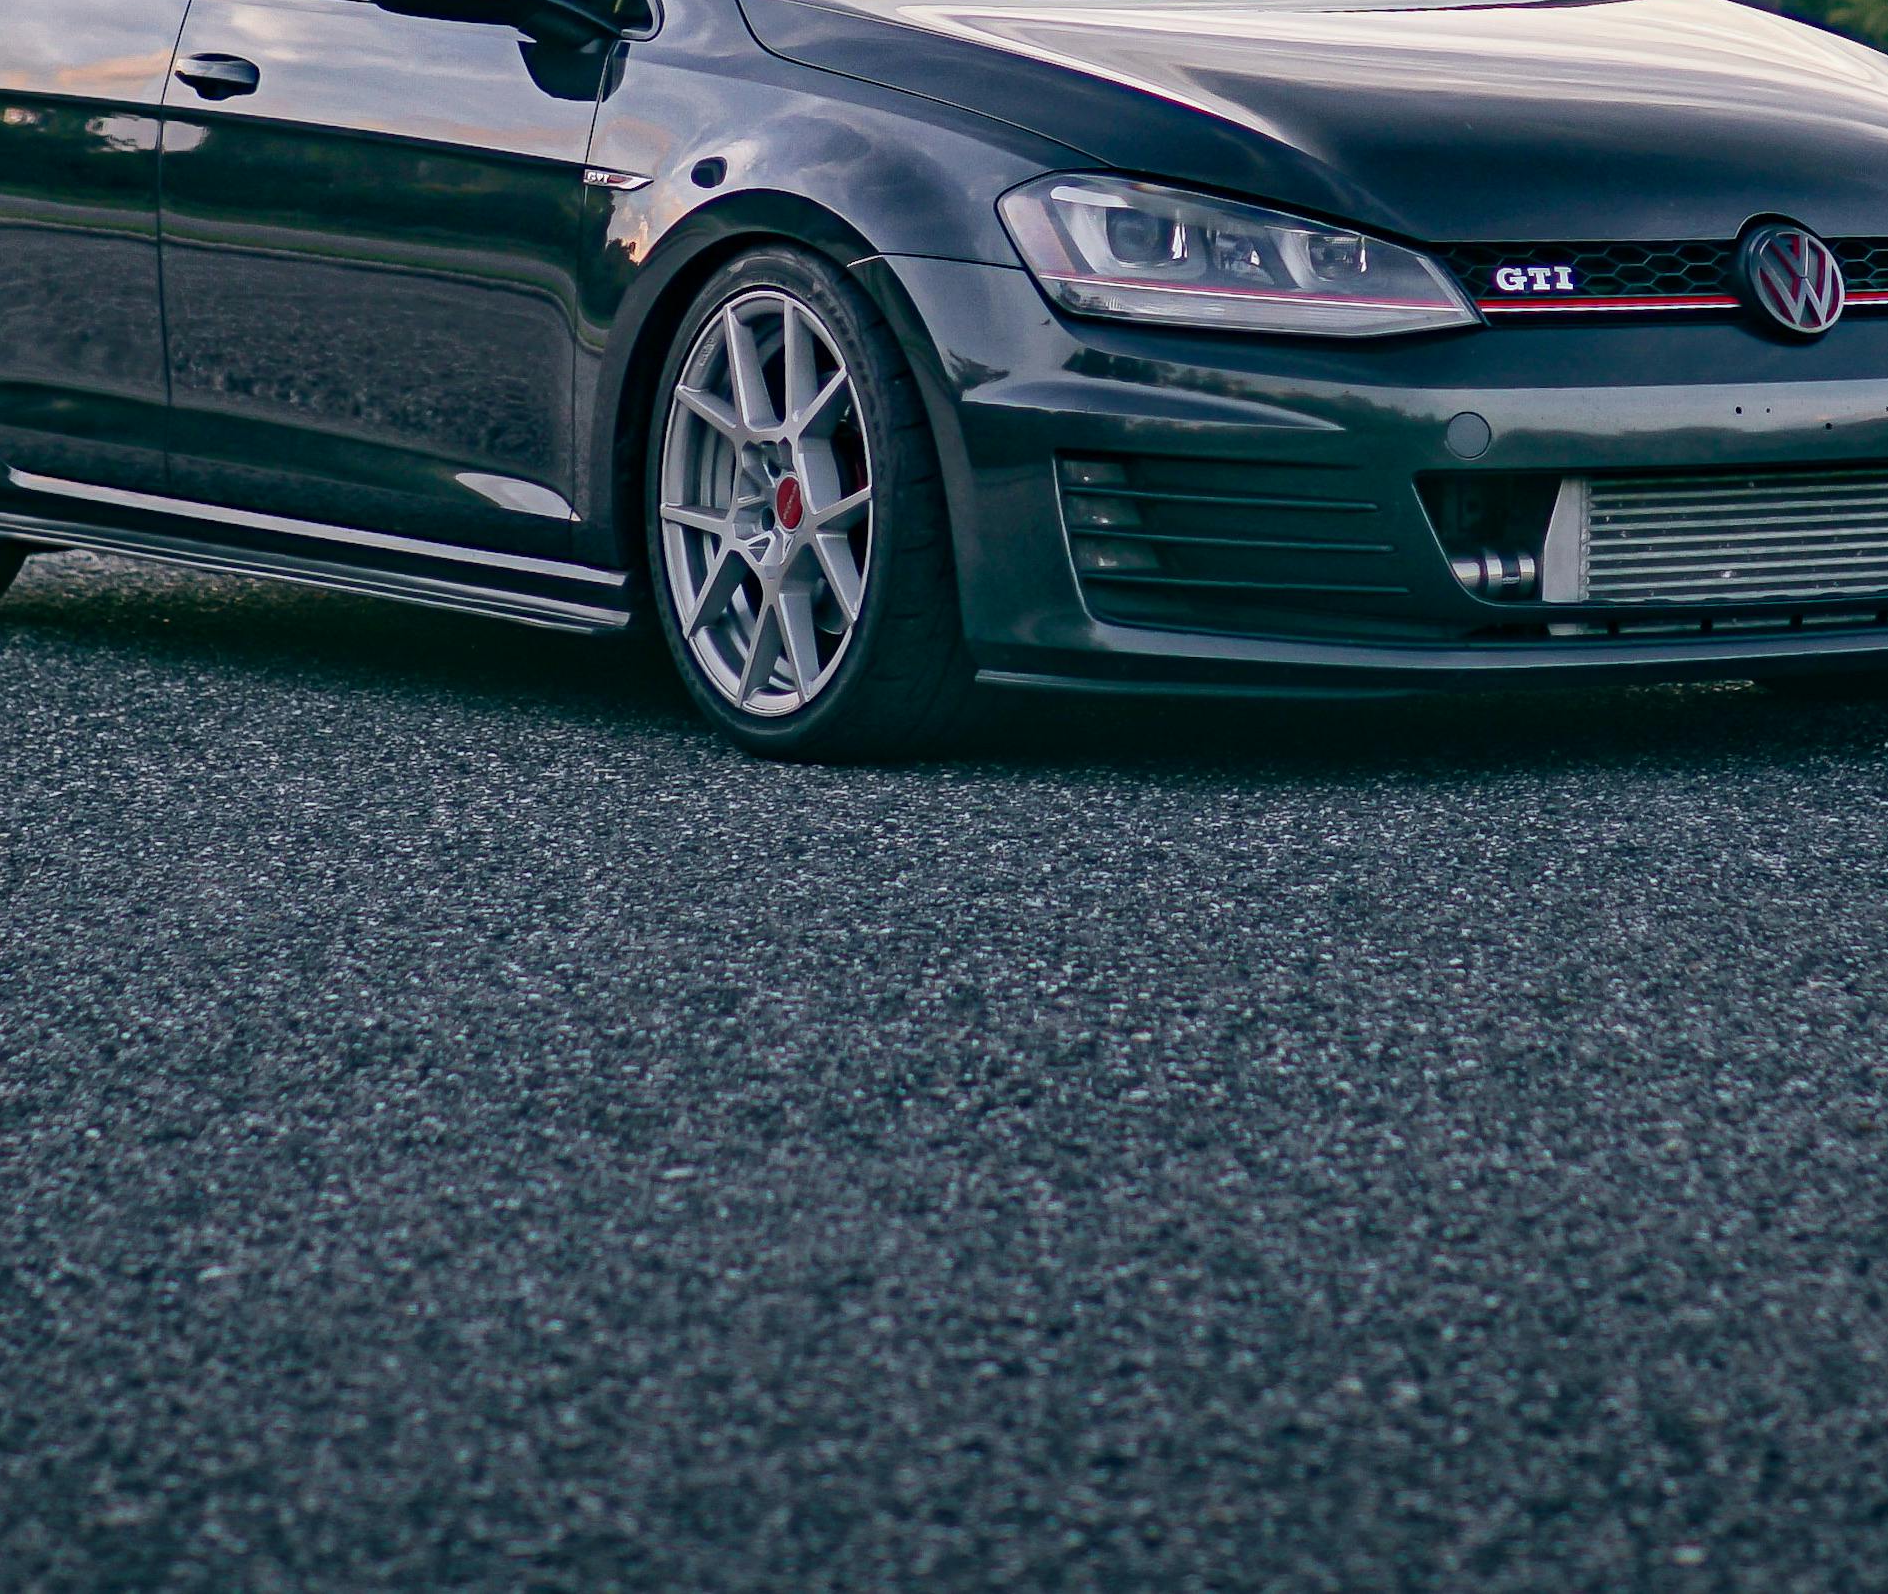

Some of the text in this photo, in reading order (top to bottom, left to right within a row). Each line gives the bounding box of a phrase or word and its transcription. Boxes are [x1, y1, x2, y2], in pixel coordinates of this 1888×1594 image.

[586, 171, 610, 184] GTI
[1496, 266, 1574, 291] GTI
[1753, 229, 1842, 330] VW
